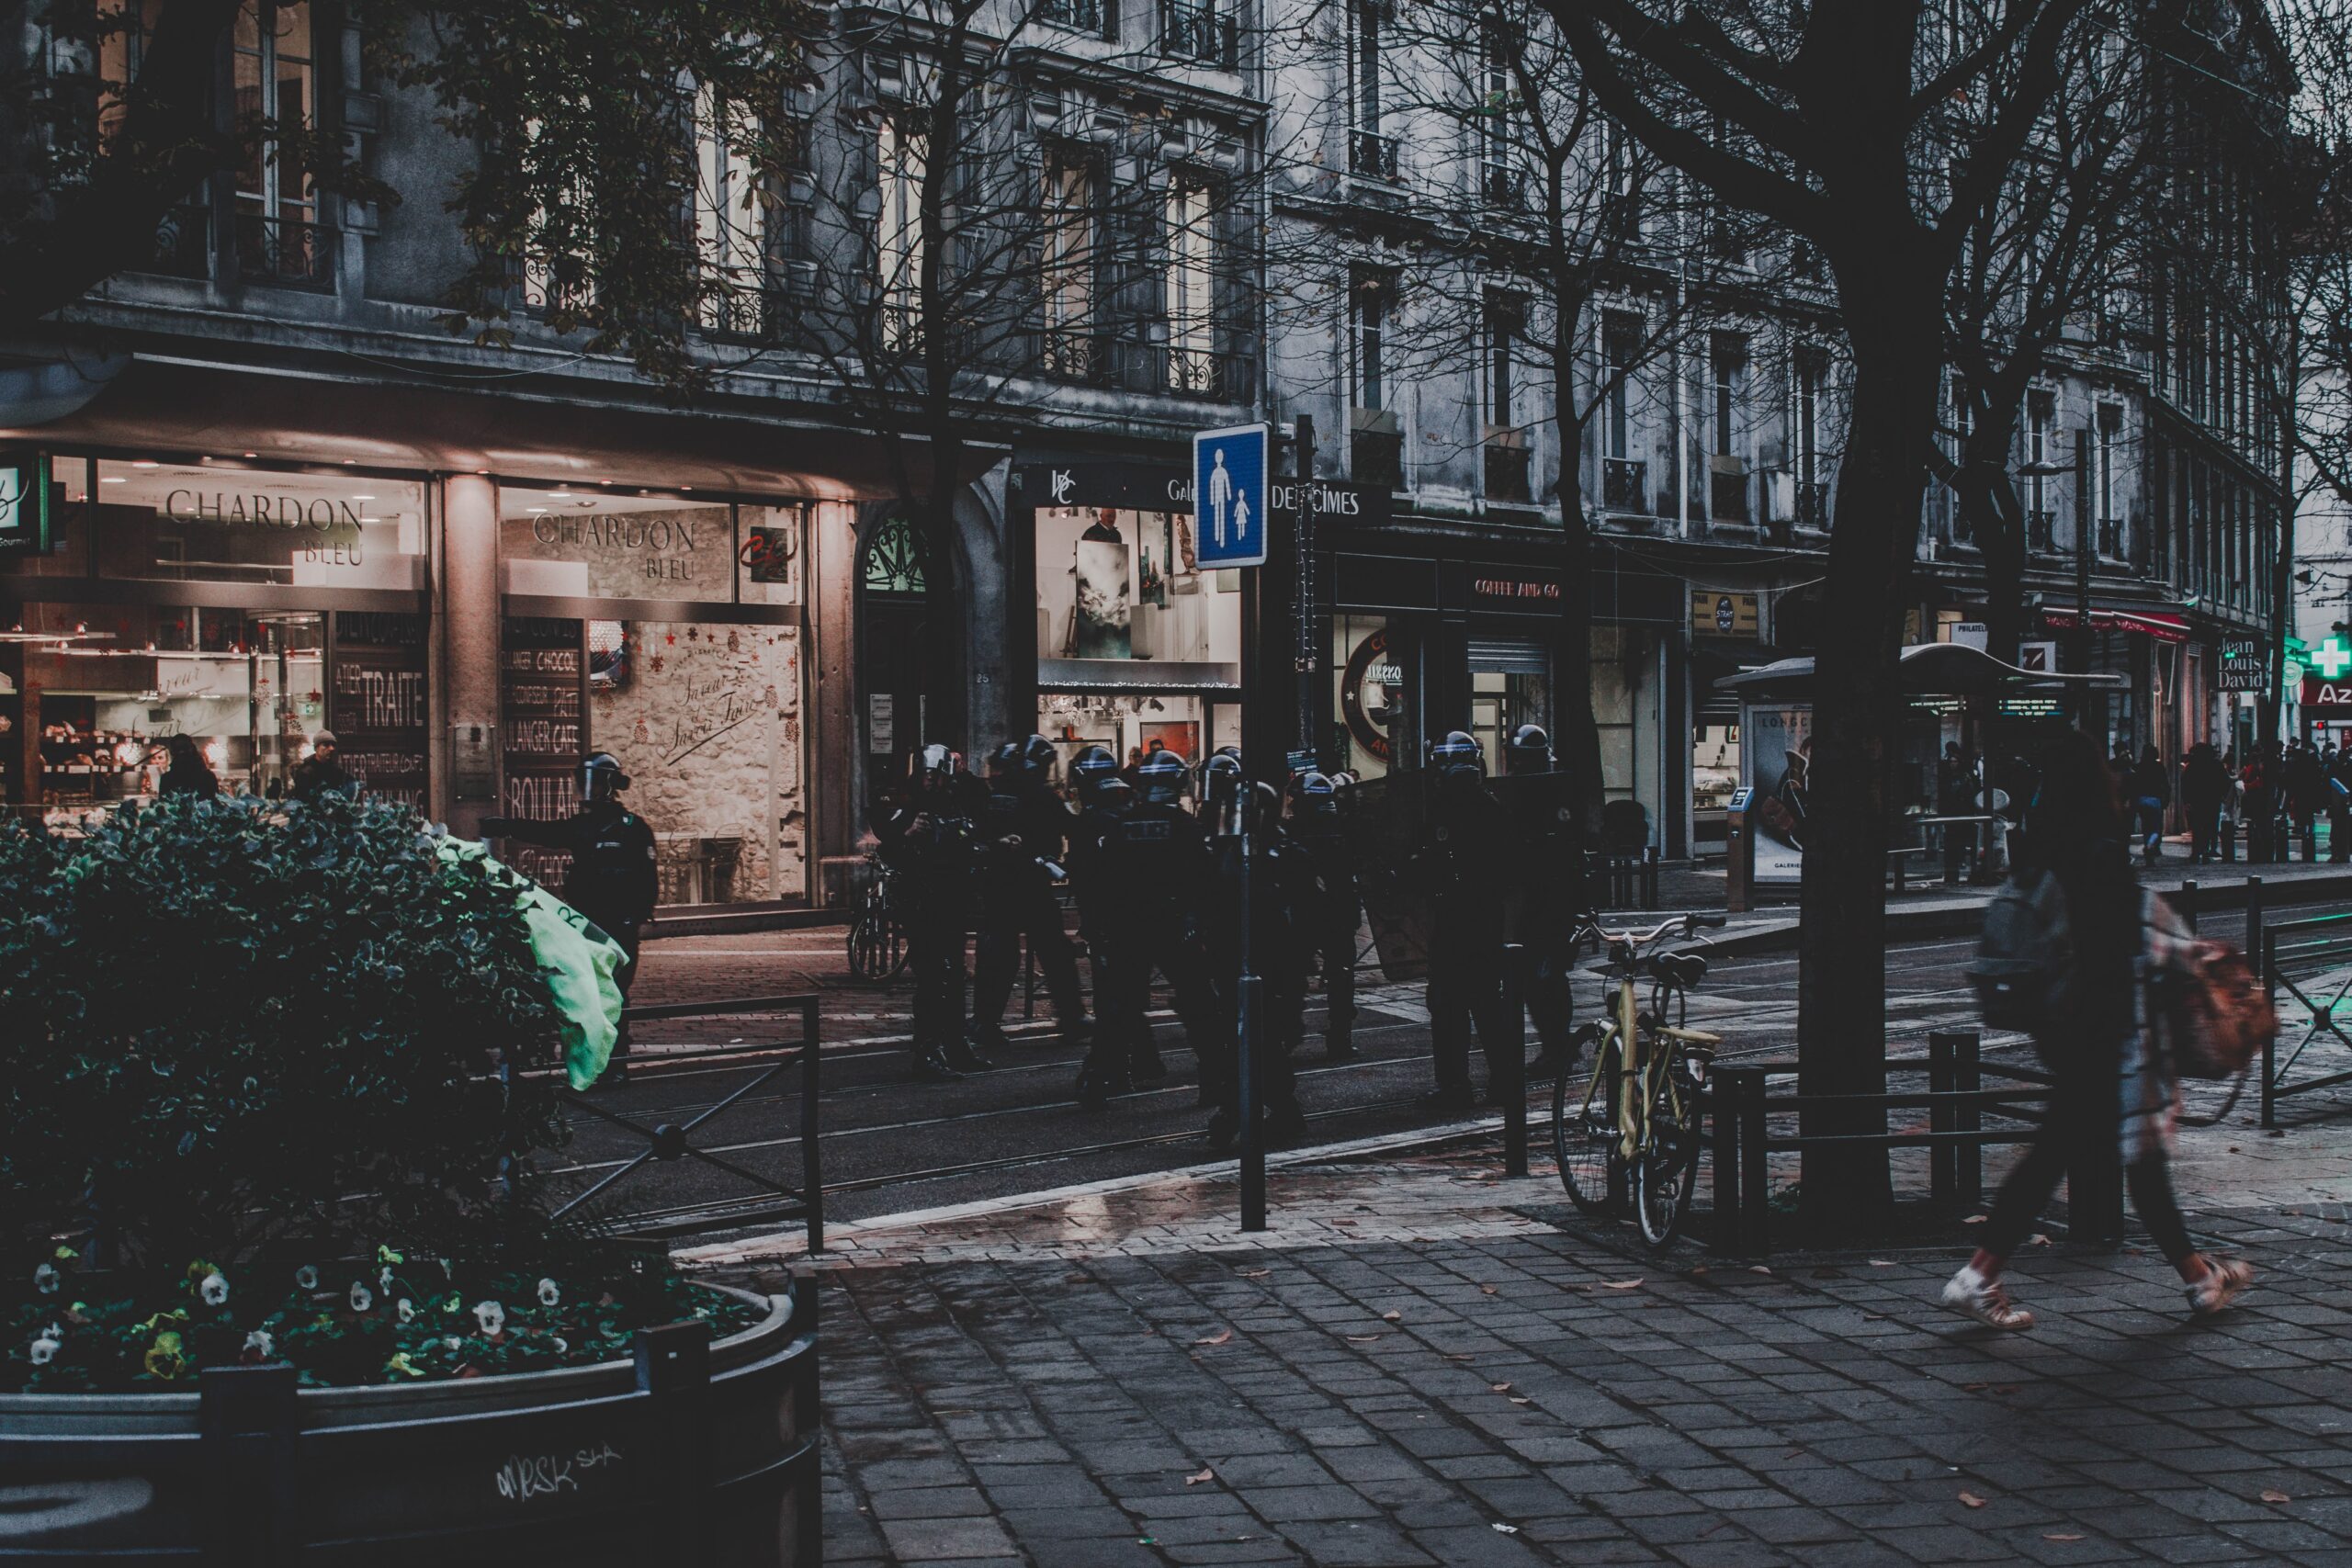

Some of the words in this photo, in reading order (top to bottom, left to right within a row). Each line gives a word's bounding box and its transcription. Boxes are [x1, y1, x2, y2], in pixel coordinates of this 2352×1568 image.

[1272, 485, 1297, 510] DE
[166, 489, 365, 533] CHARDON
[533, 513, 695, 551] CHARDON
[301, 540, 364, 567] BLEU
[646, 558, 694, 581] BLEU
[1475, 579, 1515, 596] COFFEE
[1517, 581, 1541, 598] AND
[1544, 583, 1560, 599] GO
[2217, 637, 2255, 654] Jean
[2218, 654, 2262, 671] Louis
[2218, 671, 2263, 688] David
[362, 671, 424, 727] TRAITE
[1762, 717, 1808, 728] LONGC
